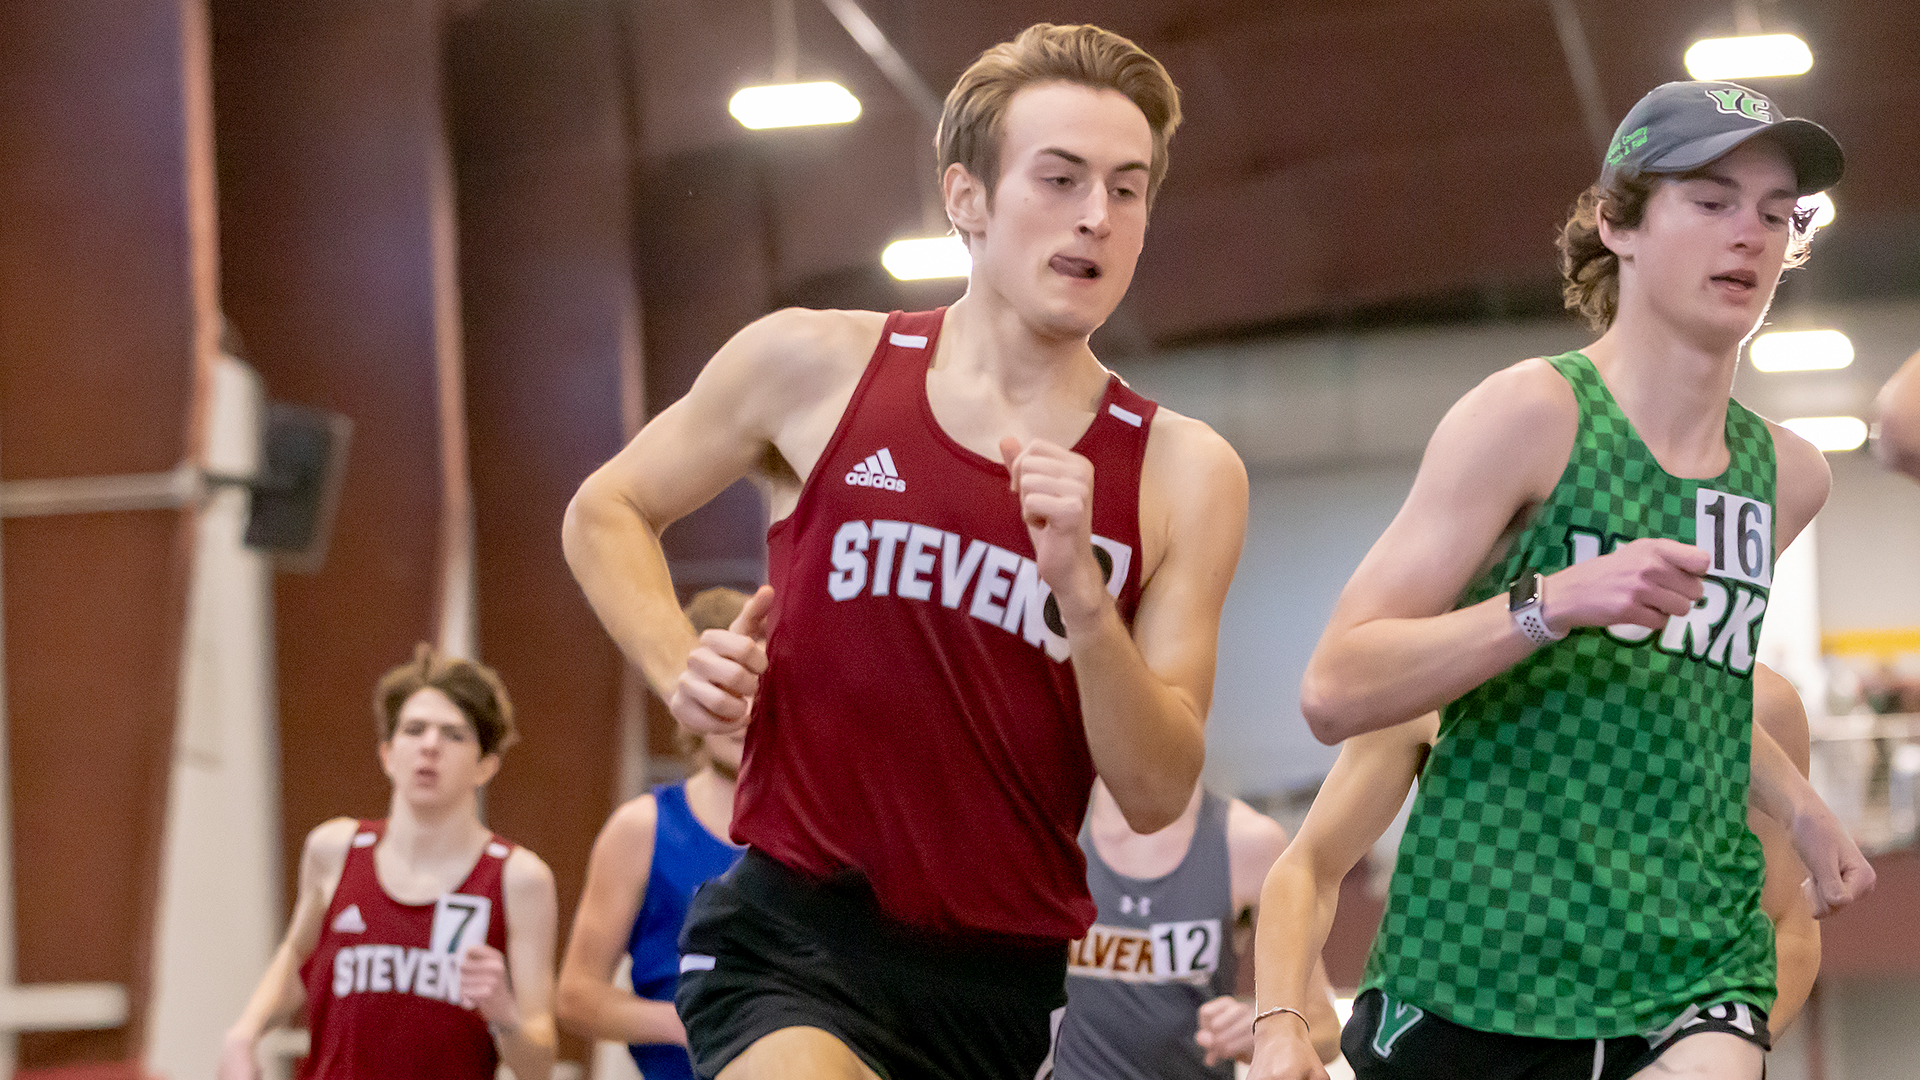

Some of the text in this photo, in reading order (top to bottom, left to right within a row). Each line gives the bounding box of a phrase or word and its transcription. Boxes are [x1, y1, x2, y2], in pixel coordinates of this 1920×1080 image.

[1705, 89, 1773, 124] YC
[845, 471, 906, 493] adidas
[1705, 496, 1764, 579] 16
[827, 519, 1071, 664] STEVEN
[1569, 530, 1767, 675] RK
[447, 904, 478, 954] 7
[1160, 926, 1209, 972] 12
[331, 943, 463, 1005] STEVEN
